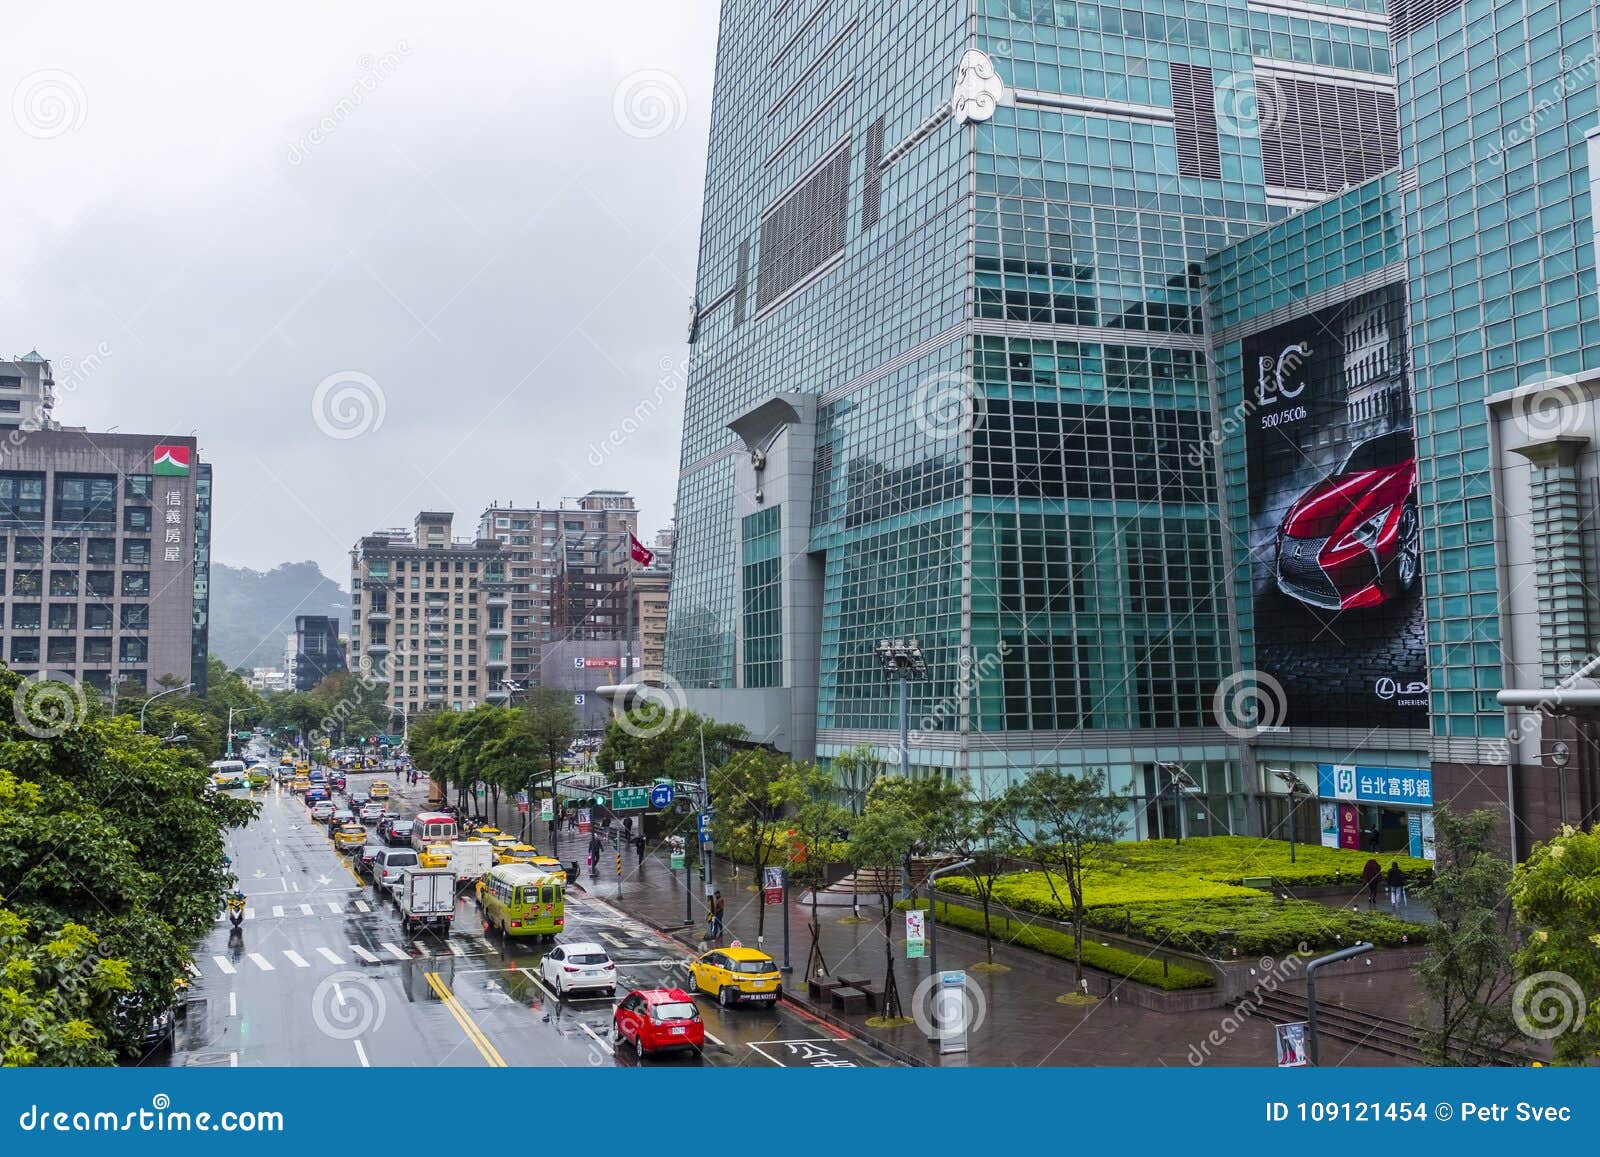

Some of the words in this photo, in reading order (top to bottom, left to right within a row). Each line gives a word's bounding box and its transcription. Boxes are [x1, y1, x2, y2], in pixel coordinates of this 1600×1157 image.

[1259, 345, 1306, 406] LC
[164, 491, 181, 562] 信義房屋
[576, 658, 584, 667] 5
[576, 695, 584, 704] 3
[1361, 776, 1431, 798] 台北富邦銀
